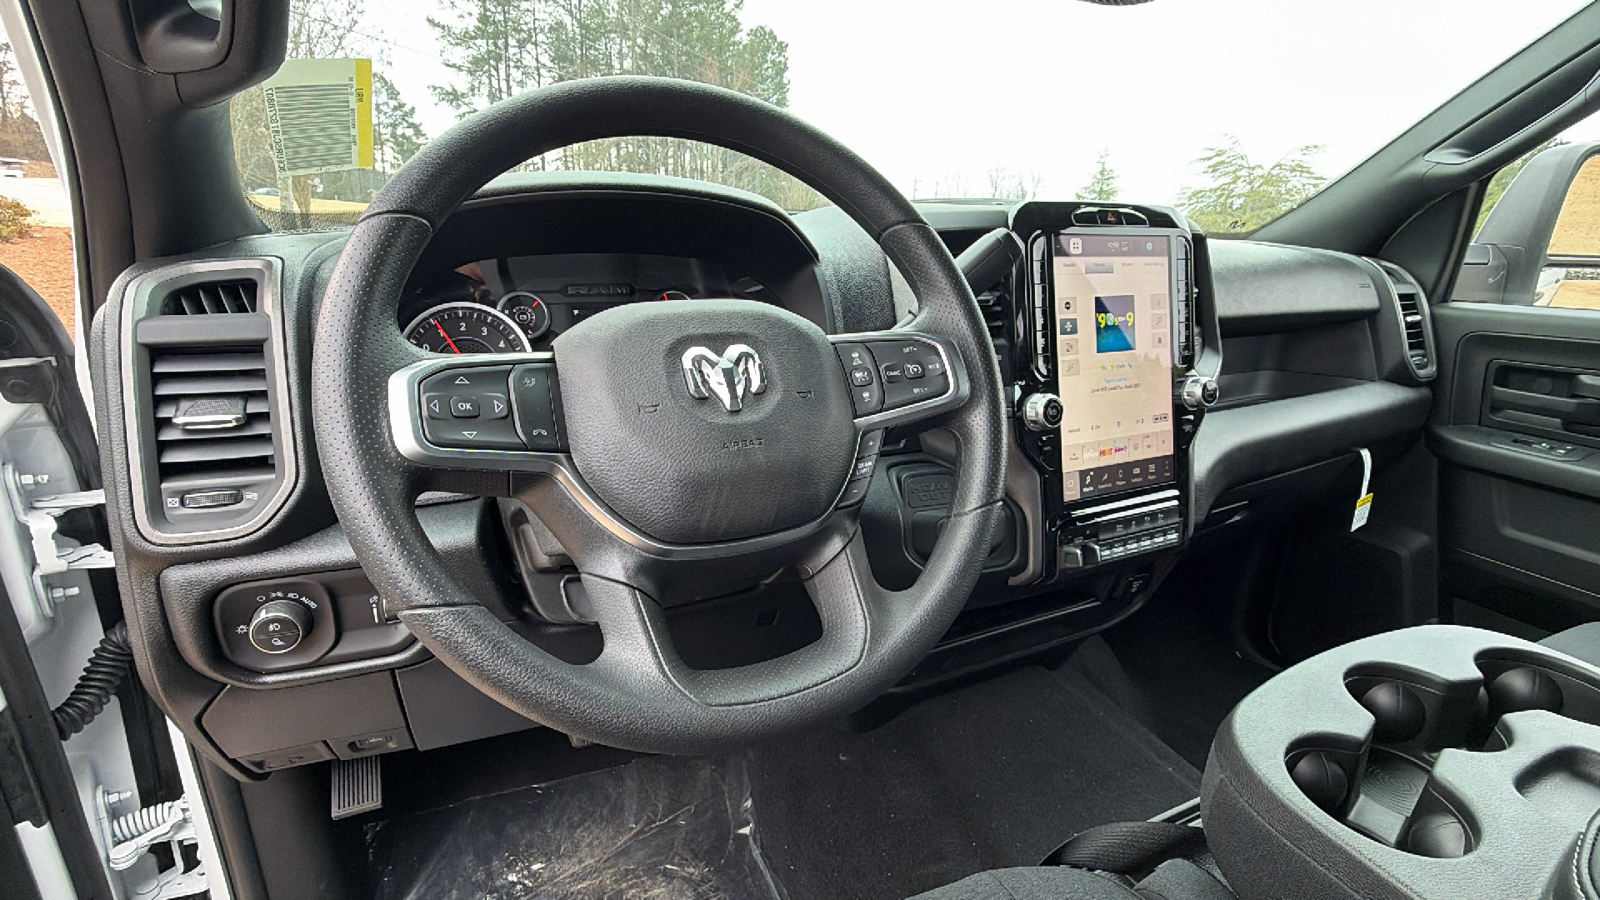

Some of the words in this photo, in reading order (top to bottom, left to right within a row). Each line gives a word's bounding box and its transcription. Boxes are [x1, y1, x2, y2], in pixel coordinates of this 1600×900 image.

[459, 322, 467, 331] 2
[481, 327, 488, 336] 3
[498, 340, 505, 348] 4
[458, 401, 473, 411] OK
[722, 438, 764, 450] AIRBAG
[300, 596, 317, 609] AUTO
